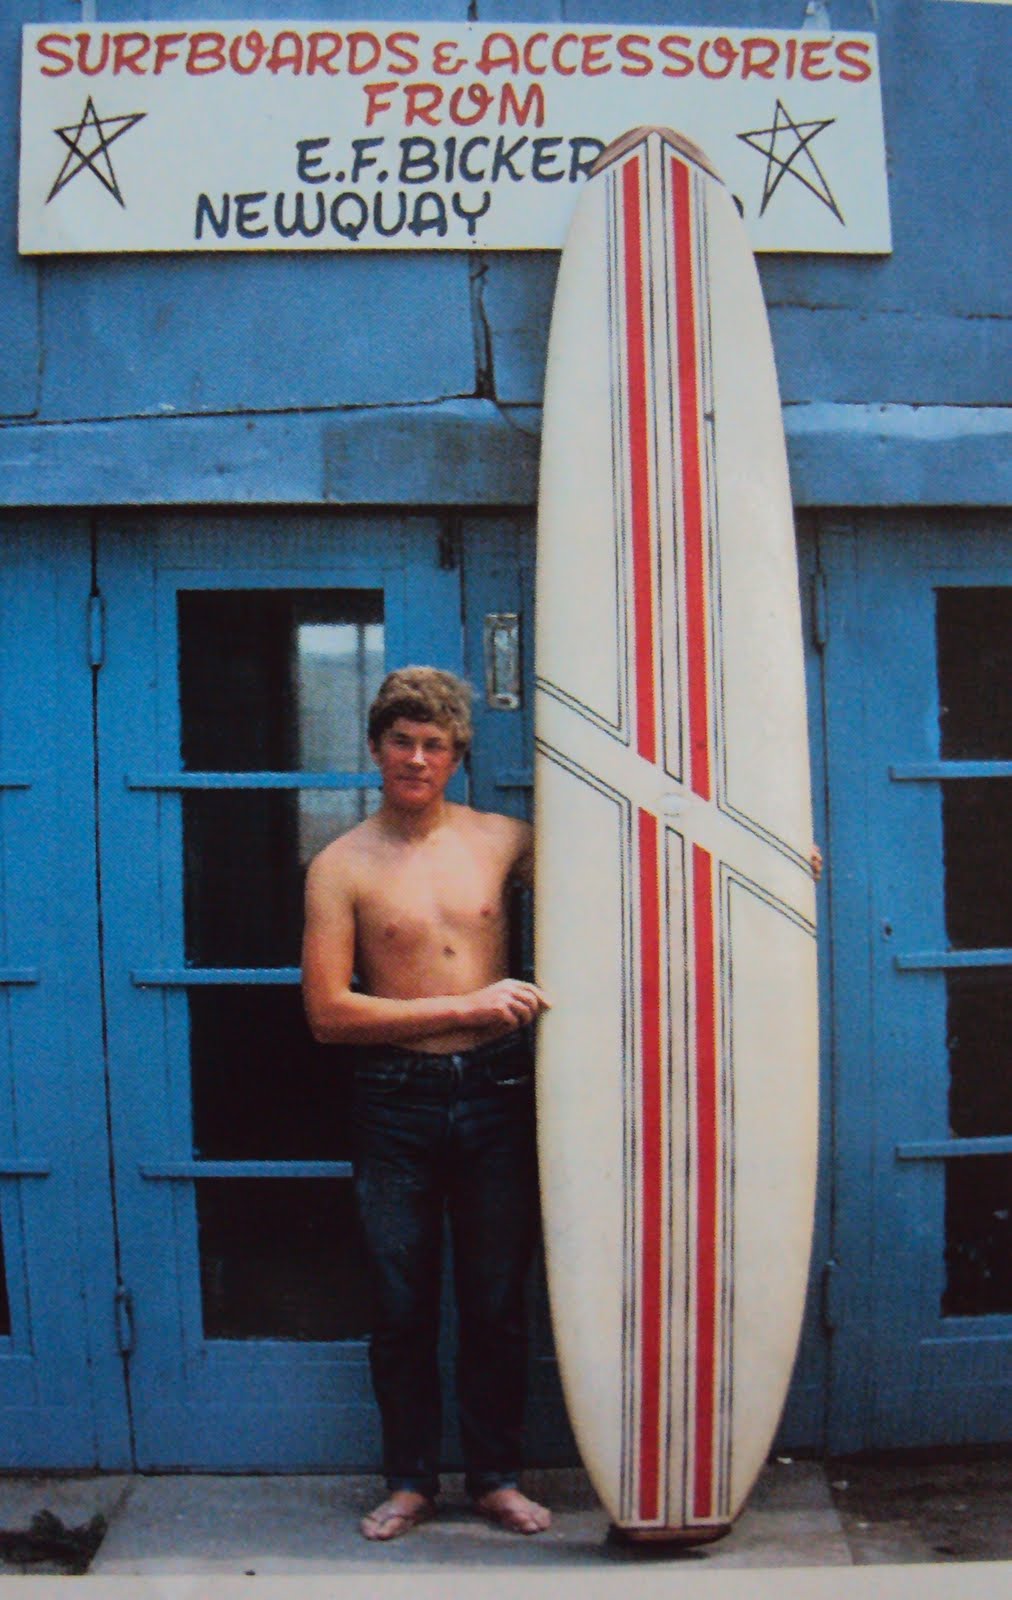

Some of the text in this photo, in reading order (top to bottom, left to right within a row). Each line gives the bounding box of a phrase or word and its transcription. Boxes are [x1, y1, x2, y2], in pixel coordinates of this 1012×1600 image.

[36, 31, 872, 83] SURFBOARDS & ACCESSORIES
[363, 82, 546, 127] FROM
[195, 191, 491, 241] NEWQUAY
